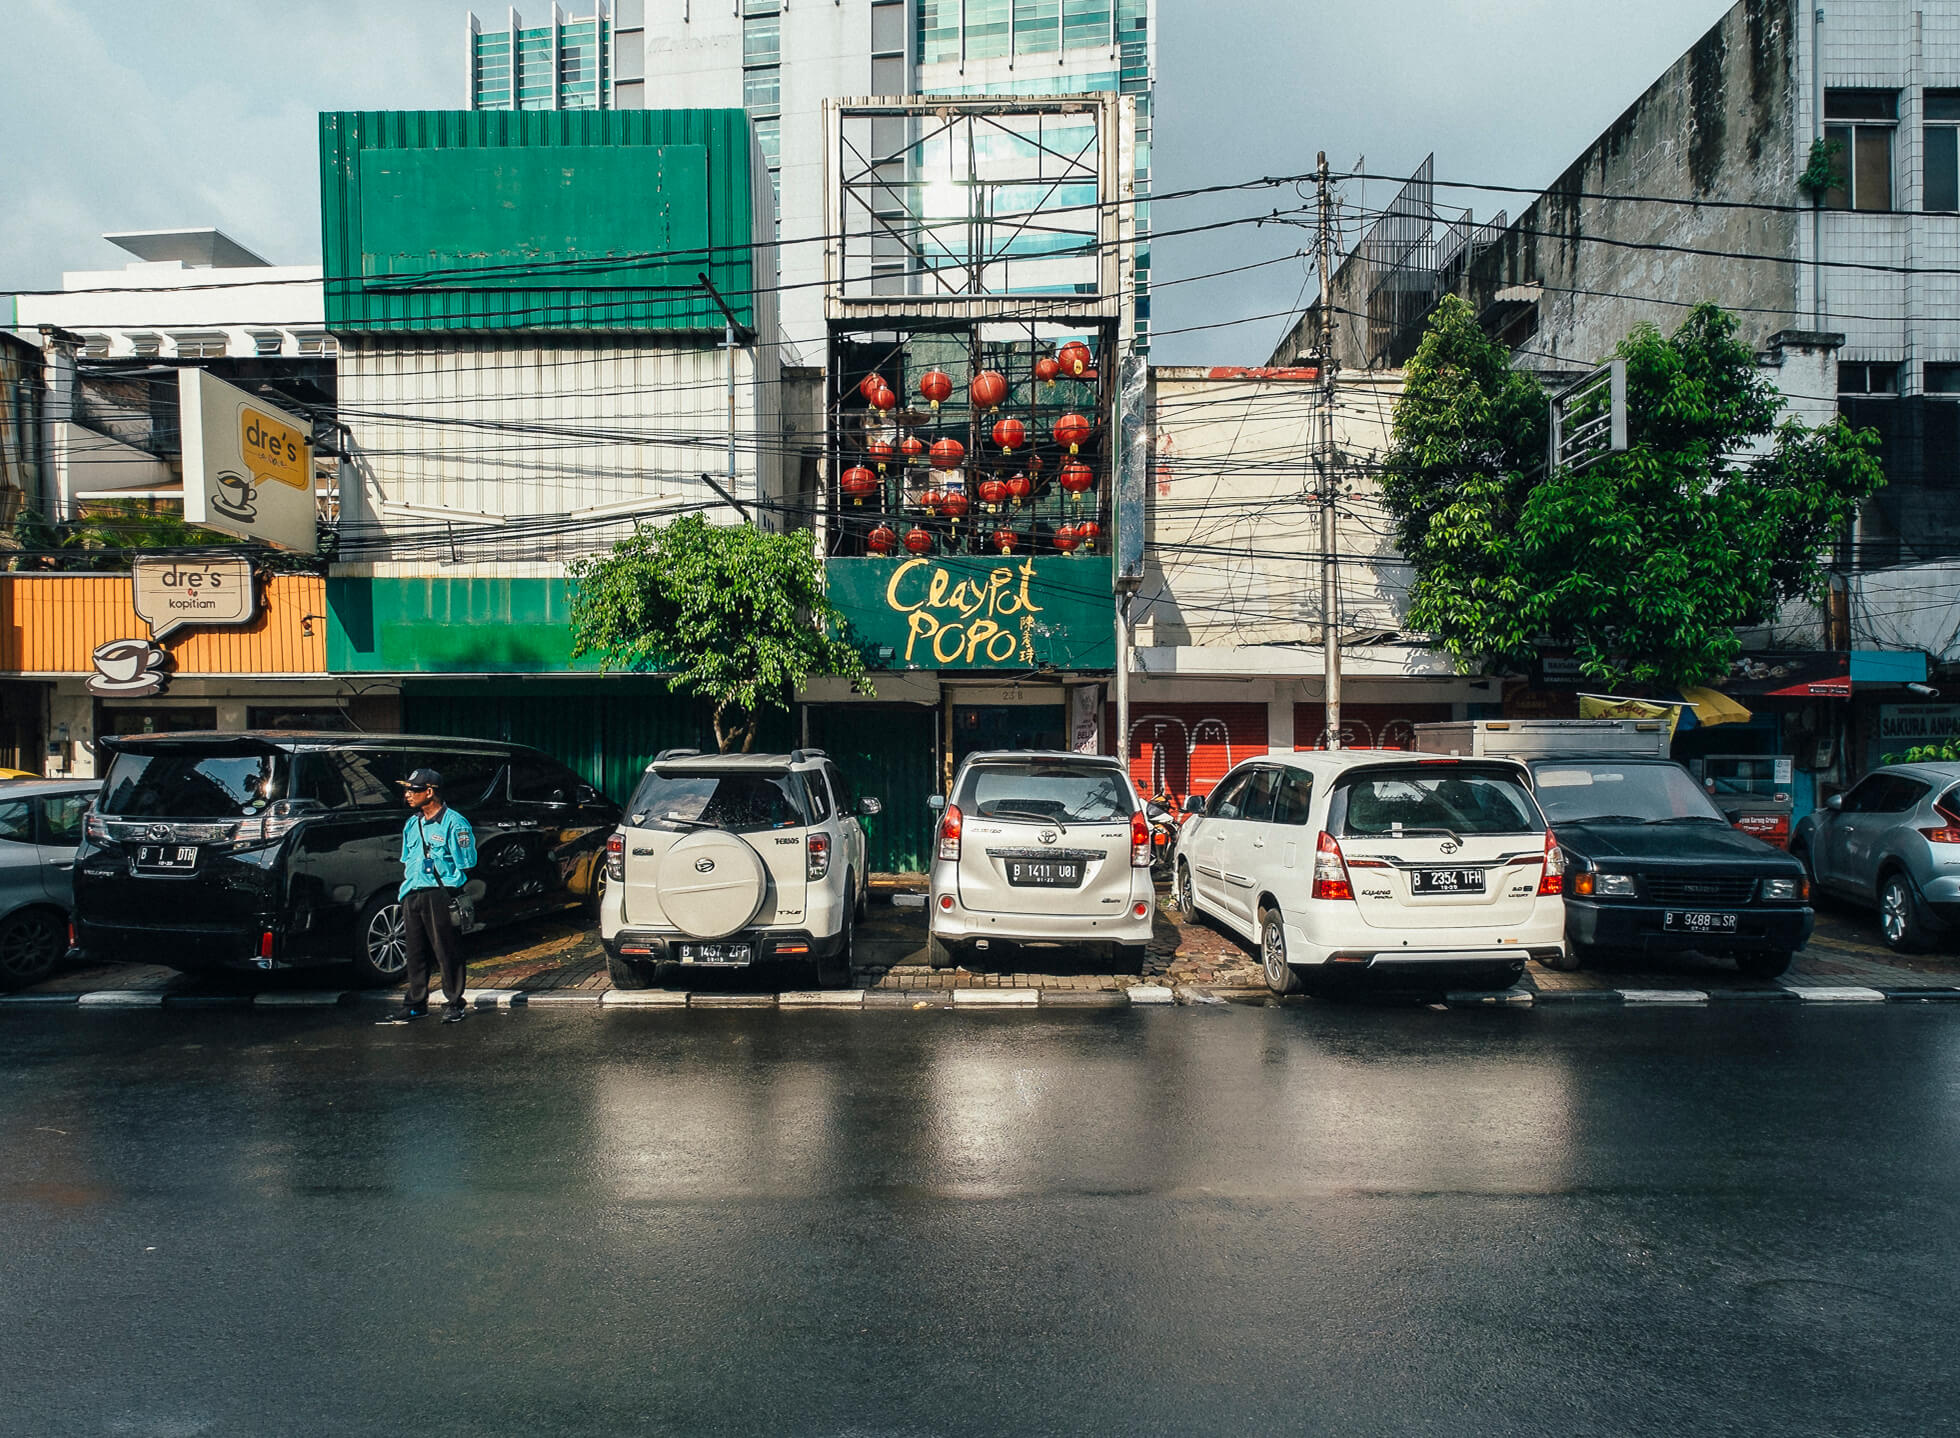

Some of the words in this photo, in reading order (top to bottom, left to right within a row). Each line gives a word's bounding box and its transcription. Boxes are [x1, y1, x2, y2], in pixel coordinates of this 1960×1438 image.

[246, 419, 297, 462] dre's
[162, 563, 221, 588] dre's
[169, 598, 216, 610] kopitiam
[1883, 717, 1928, 736] SAKURA
[141, 848, 148, 860] B
[160, 848, 164, 860] 1
[177, 848, 194, 861] DTH
[1014, 864, 1021, 876] B
[1028, 864, 1050, 877] 1411
[1413, 873, 1421, 886] B
[1431, 871, 1457, 884] 2354
[1463, 870, 1482, 883] TFH
[1666, 912, 1673, 925] B
[1684, 913, 1711, 926] 9488
[1722, 915, 1736, 927] SR
[682, 945, 690, 957] B
[728, 945, 748, 958] ZFP
